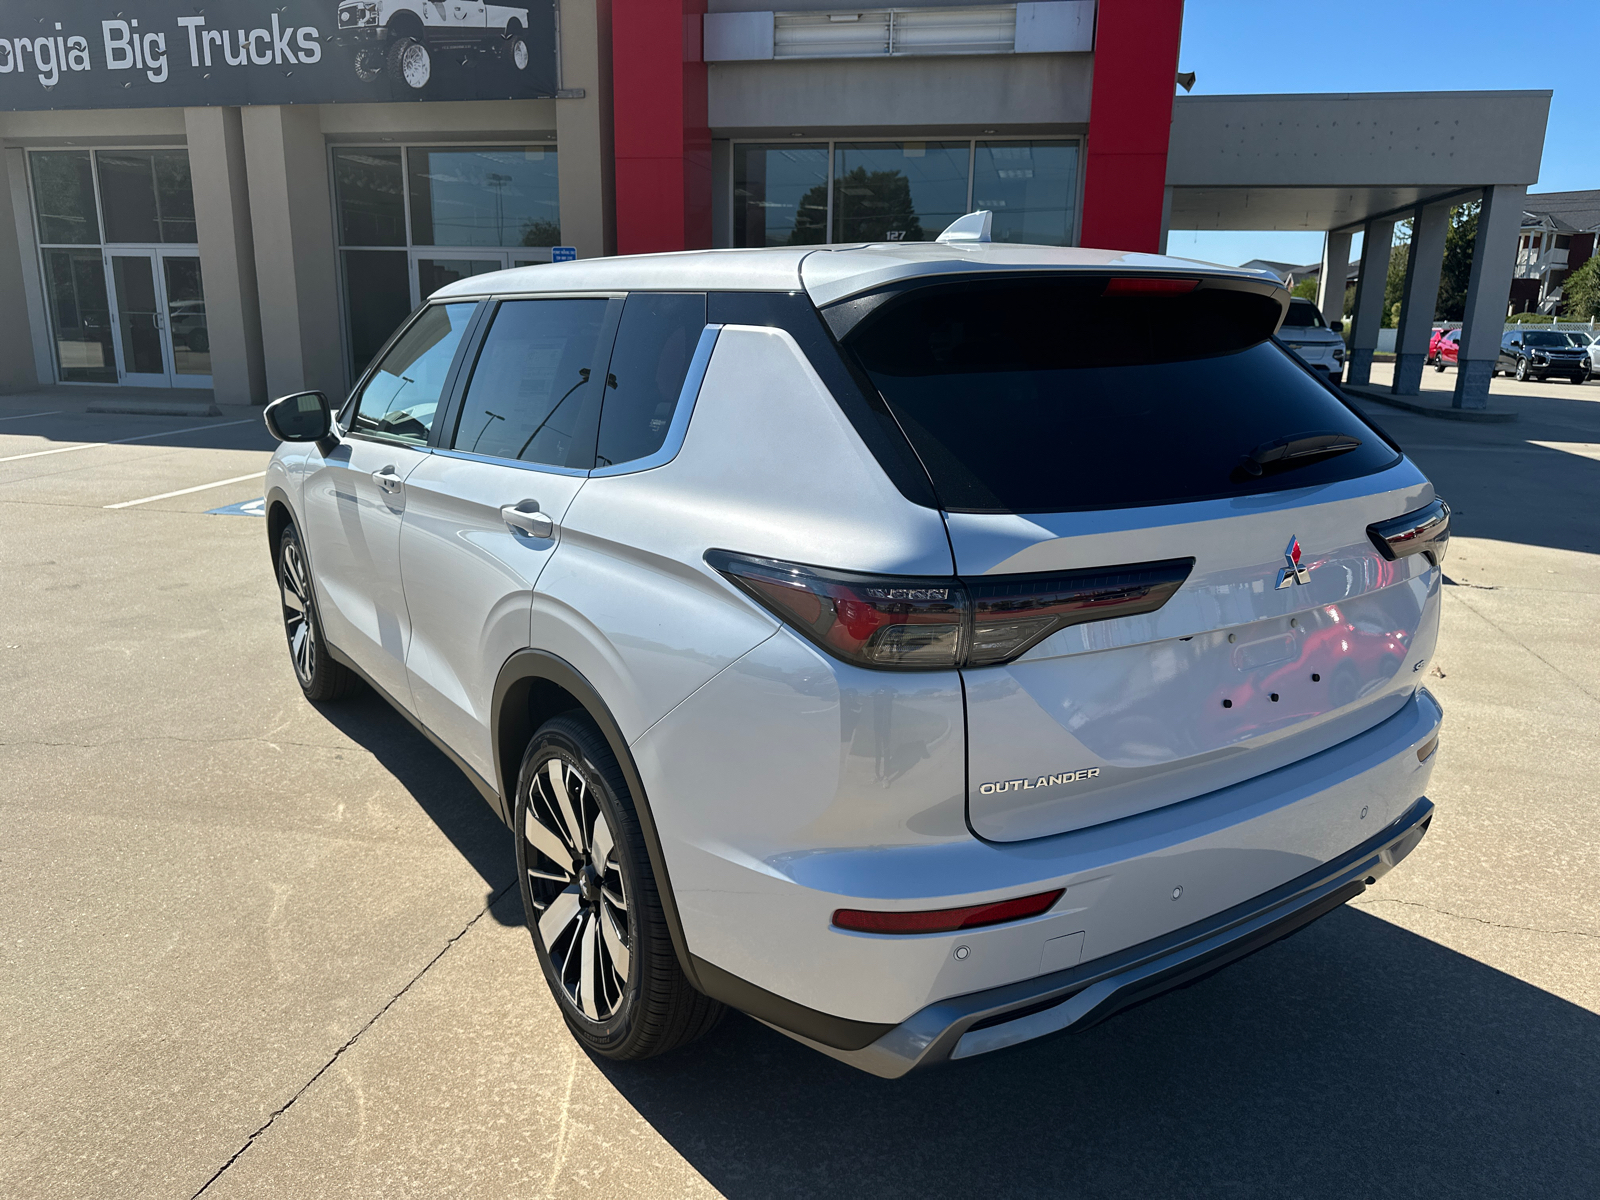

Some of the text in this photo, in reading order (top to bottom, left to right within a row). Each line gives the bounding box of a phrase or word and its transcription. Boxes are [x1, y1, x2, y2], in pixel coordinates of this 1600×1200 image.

[101, 19, 169, 83] Big
[177, 13, 322, 66] Trucks
[886, 231, 907, 241] 127
[979, 767, 1100, 795] OUTLANDER
